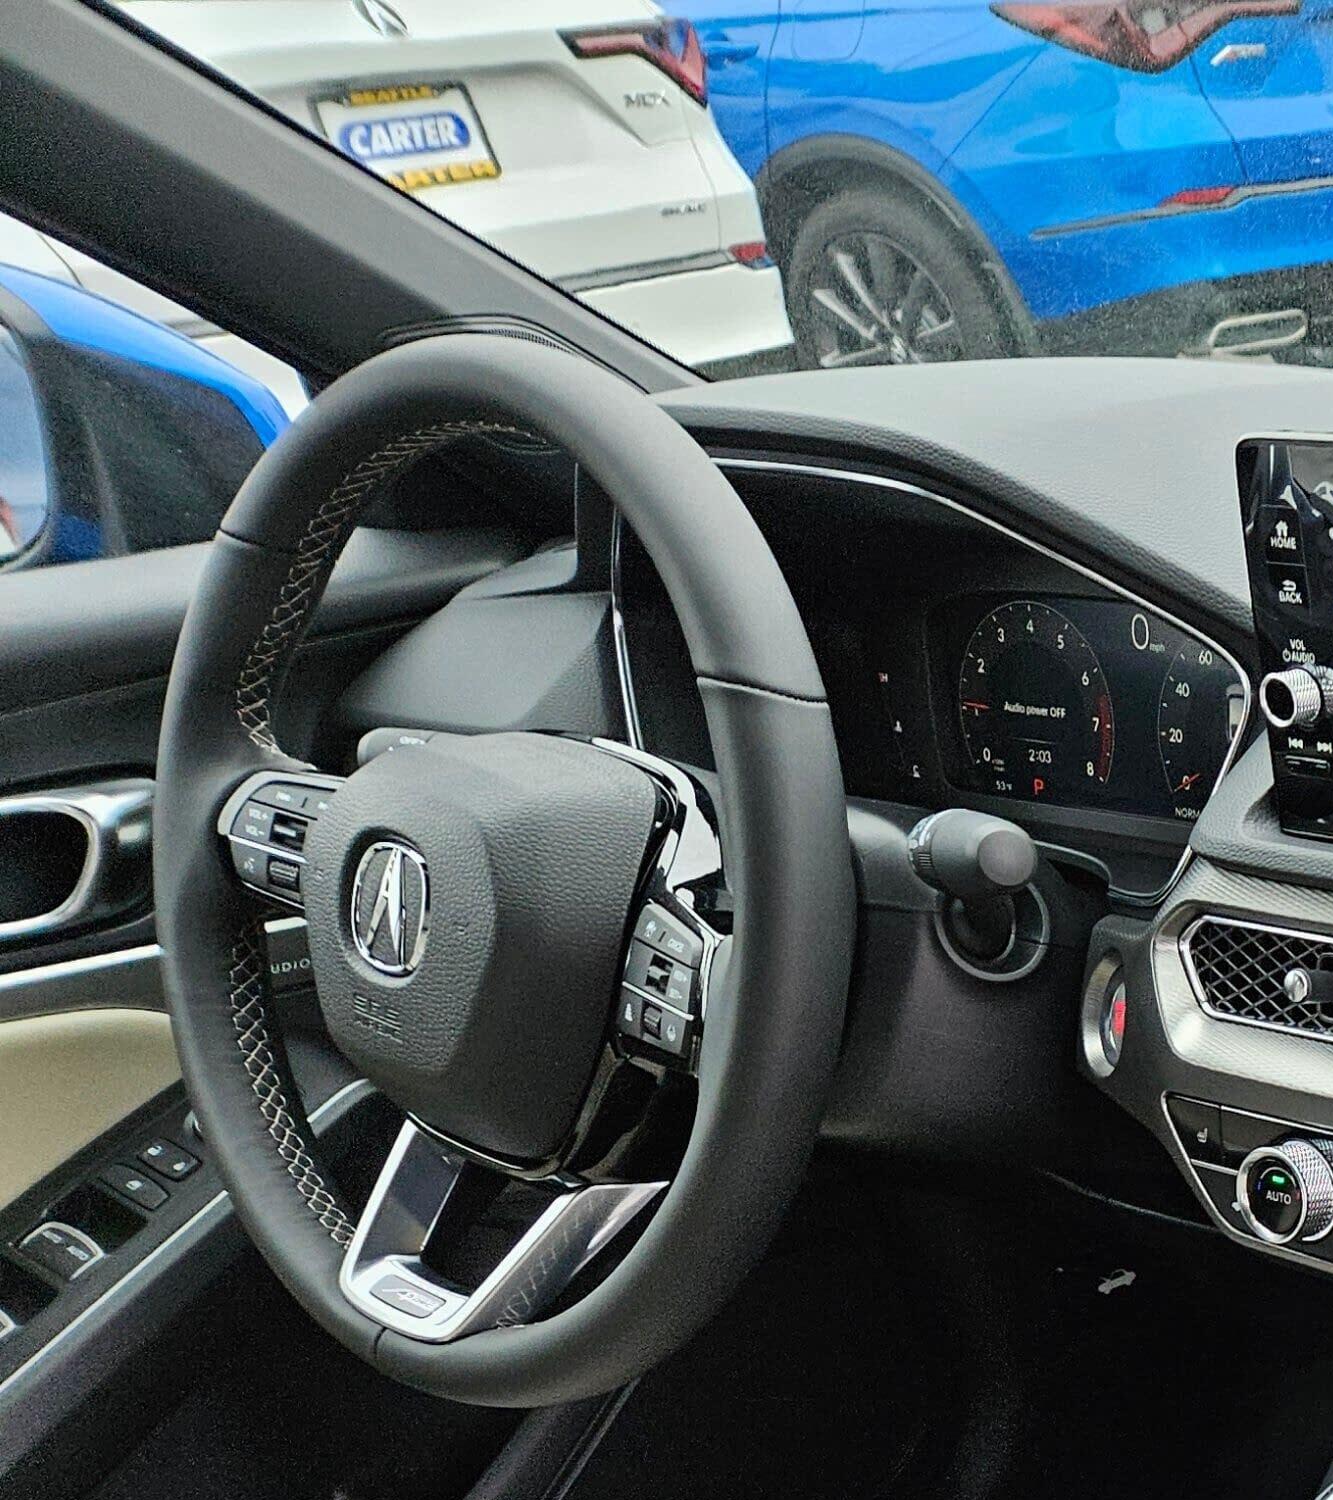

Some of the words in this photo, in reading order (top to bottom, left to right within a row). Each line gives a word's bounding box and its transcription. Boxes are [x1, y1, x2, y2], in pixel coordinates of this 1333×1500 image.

[350, 115, 457, 156] CARTER
[387, 160, 496, 190] ARTER
[1270, 537, 1297, 550] HOME
[1279, 591, 1302, 604] BACK
[1026, 619, 1034, 633] 4
[1132, 613, 1149, 649] 0
[997, 628, 1005, 642] 3
[1057, 634, 1065, 649] 5
[1290, 638, 1306, 650] VOL
[1199, 650, 1213, 665] 60
[1291, 651, 1316, 663] AUDIO
[977, 658, 985, 673] 2
[1081, 671, 1089, 686] 6
[1175, 683, 1190, 697] 40
[1004, 701, 1025, 713] Audio
[1050, 707, 1066, 719] OFF
[1092, 717, 1099, 732] 7
[1169, 728, 1183, 743] 20
[983, 747, 990, 761] 0
[1029, 749, 1051, 763] 2:03
[1086, 761, 1094, 776] 8
[1034, 779, 1045, 795] P
[1265, 1189, 1292, 1205] AUTO
